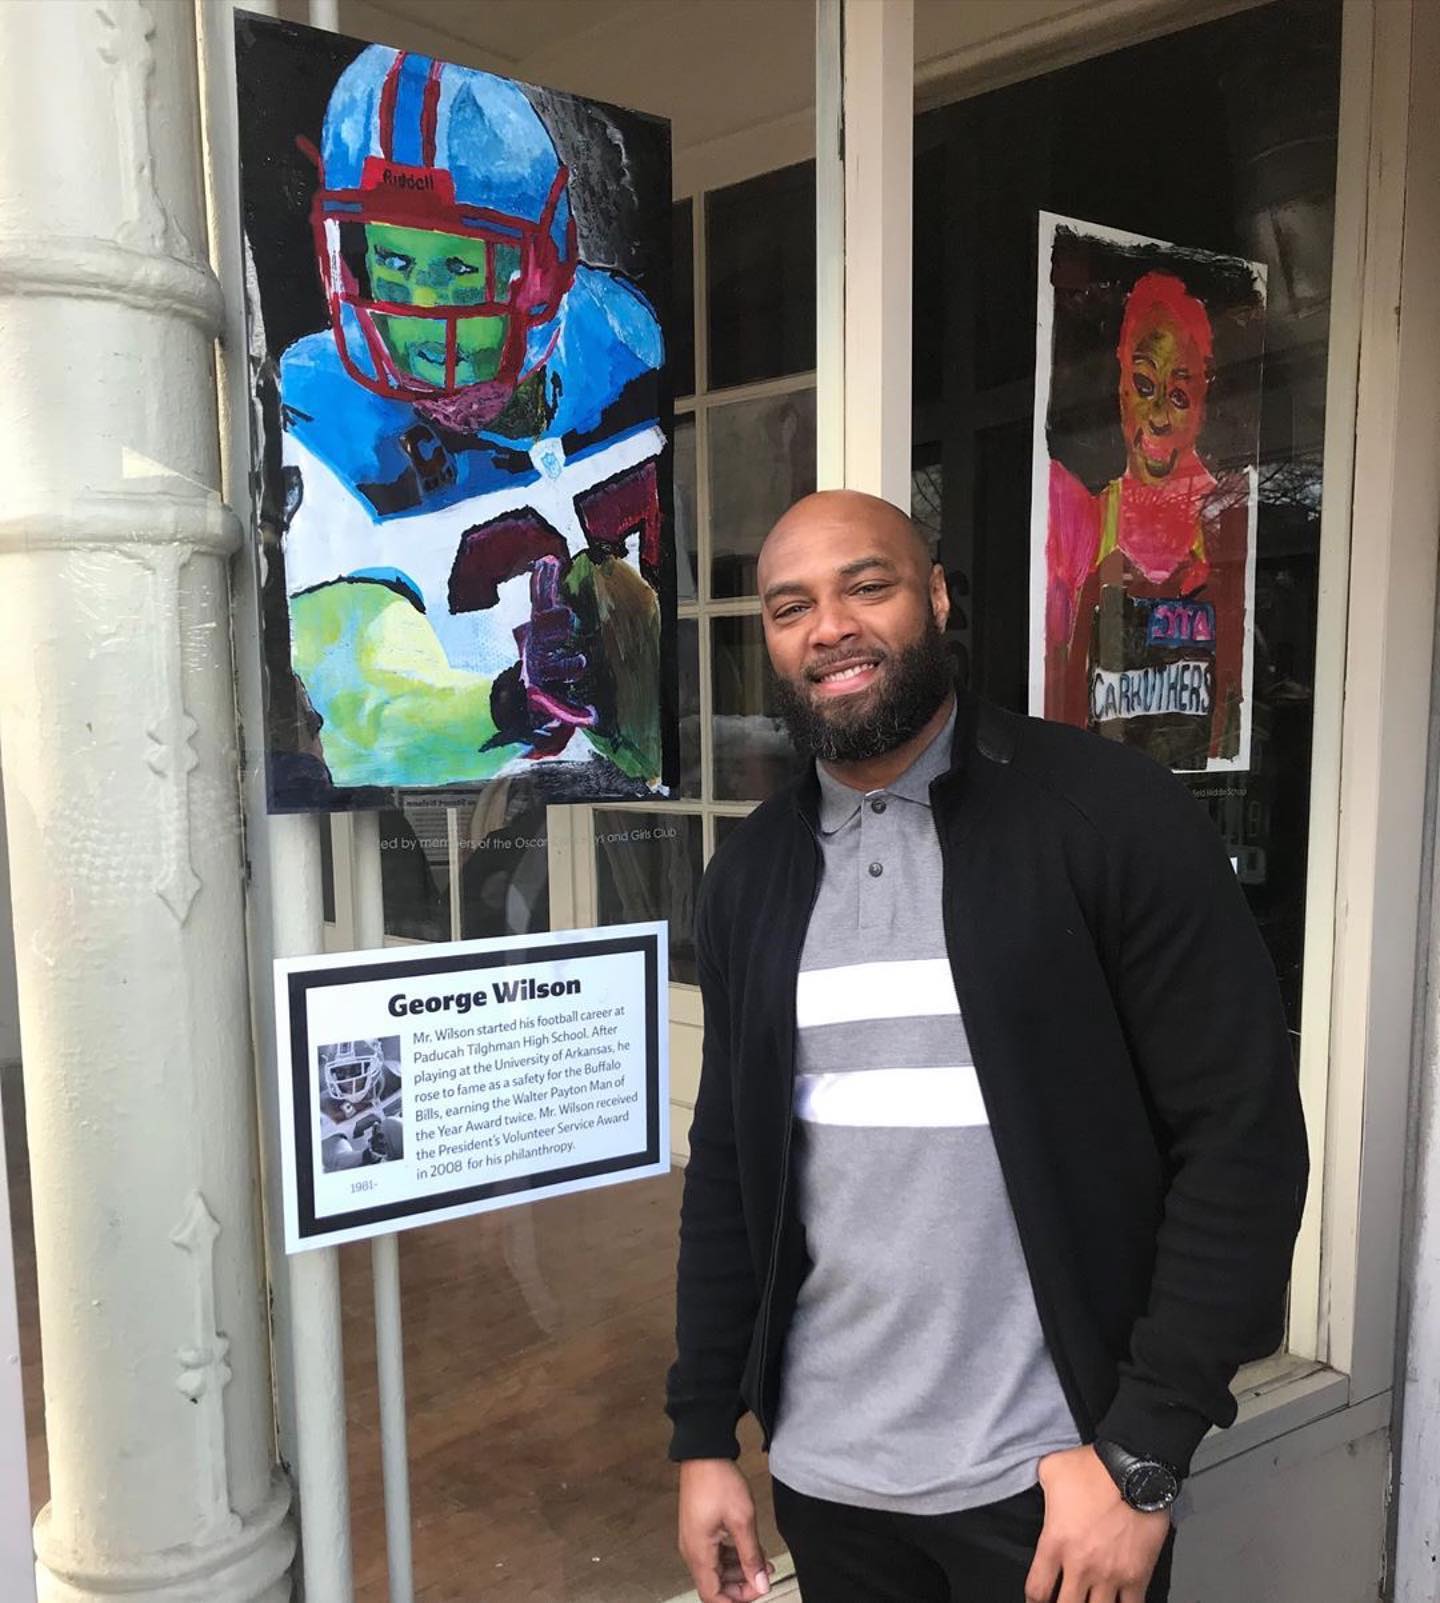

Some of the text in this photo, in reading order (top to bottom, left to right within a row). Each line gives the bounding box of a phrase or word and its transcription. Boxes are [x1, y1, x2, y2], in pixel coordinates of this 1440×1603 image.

[401, 837, 416, 850] by
[419, 837, 476, 850] memers
[493, 837, 512, 849] the
[607, 831, 628, 842] and
[653, 827, 677, 838] Club
[388, 978, 581, 1017] George Wilson
[413, 1006, 625, 1045] Mr. Wilson started his football career at
[413, 1024, 618, 1064] Paducah Tilghman High School. After
[413, 1040, 630, 1086] playing at the University of Arkansas, he
[414, 1060, 621, 1103] rose to fame as a safety for the Buffalo
[415, 1075, 625, 1122] Bills, earning the Walter Payton Man of
[416, 1091, 638, 1141] the Year Award twice. Mr. Wilson received
[416, 1148, 436, 1161] the
[502, 1125, 555, 1144] Volunteer
[557, 1119, 594, 1134] Service
[596, 1110, 630, 1126] Award
[416, 1141, 575, 1180] in 2008 for his philanthropy.
